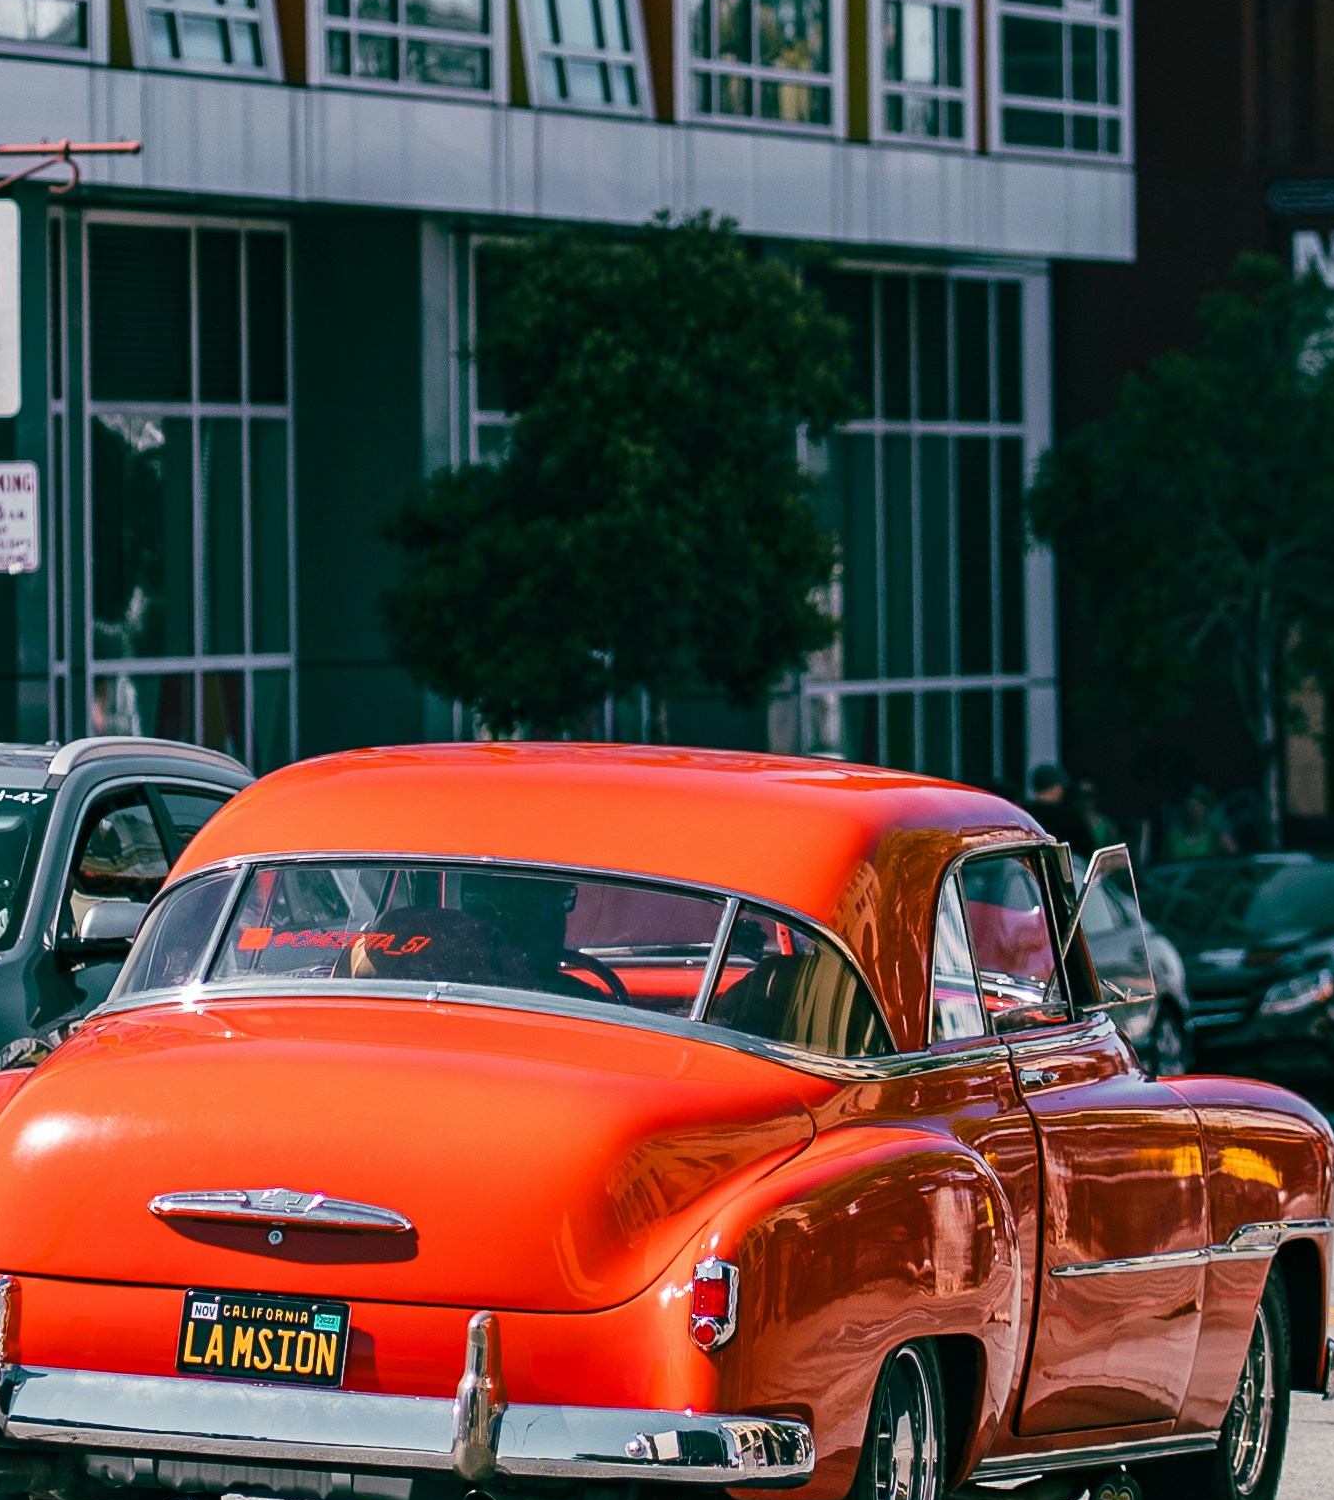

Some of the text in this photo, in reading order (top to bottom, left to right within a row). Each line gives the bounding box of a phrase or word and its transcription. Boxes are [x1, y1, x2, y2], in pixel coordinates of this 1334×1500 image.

[194, 1304, 216, 1318] NOV
[223, 1304, 308, 1324] CALIFORNIA
[183, 1321, 338, 1376] LA MSION
